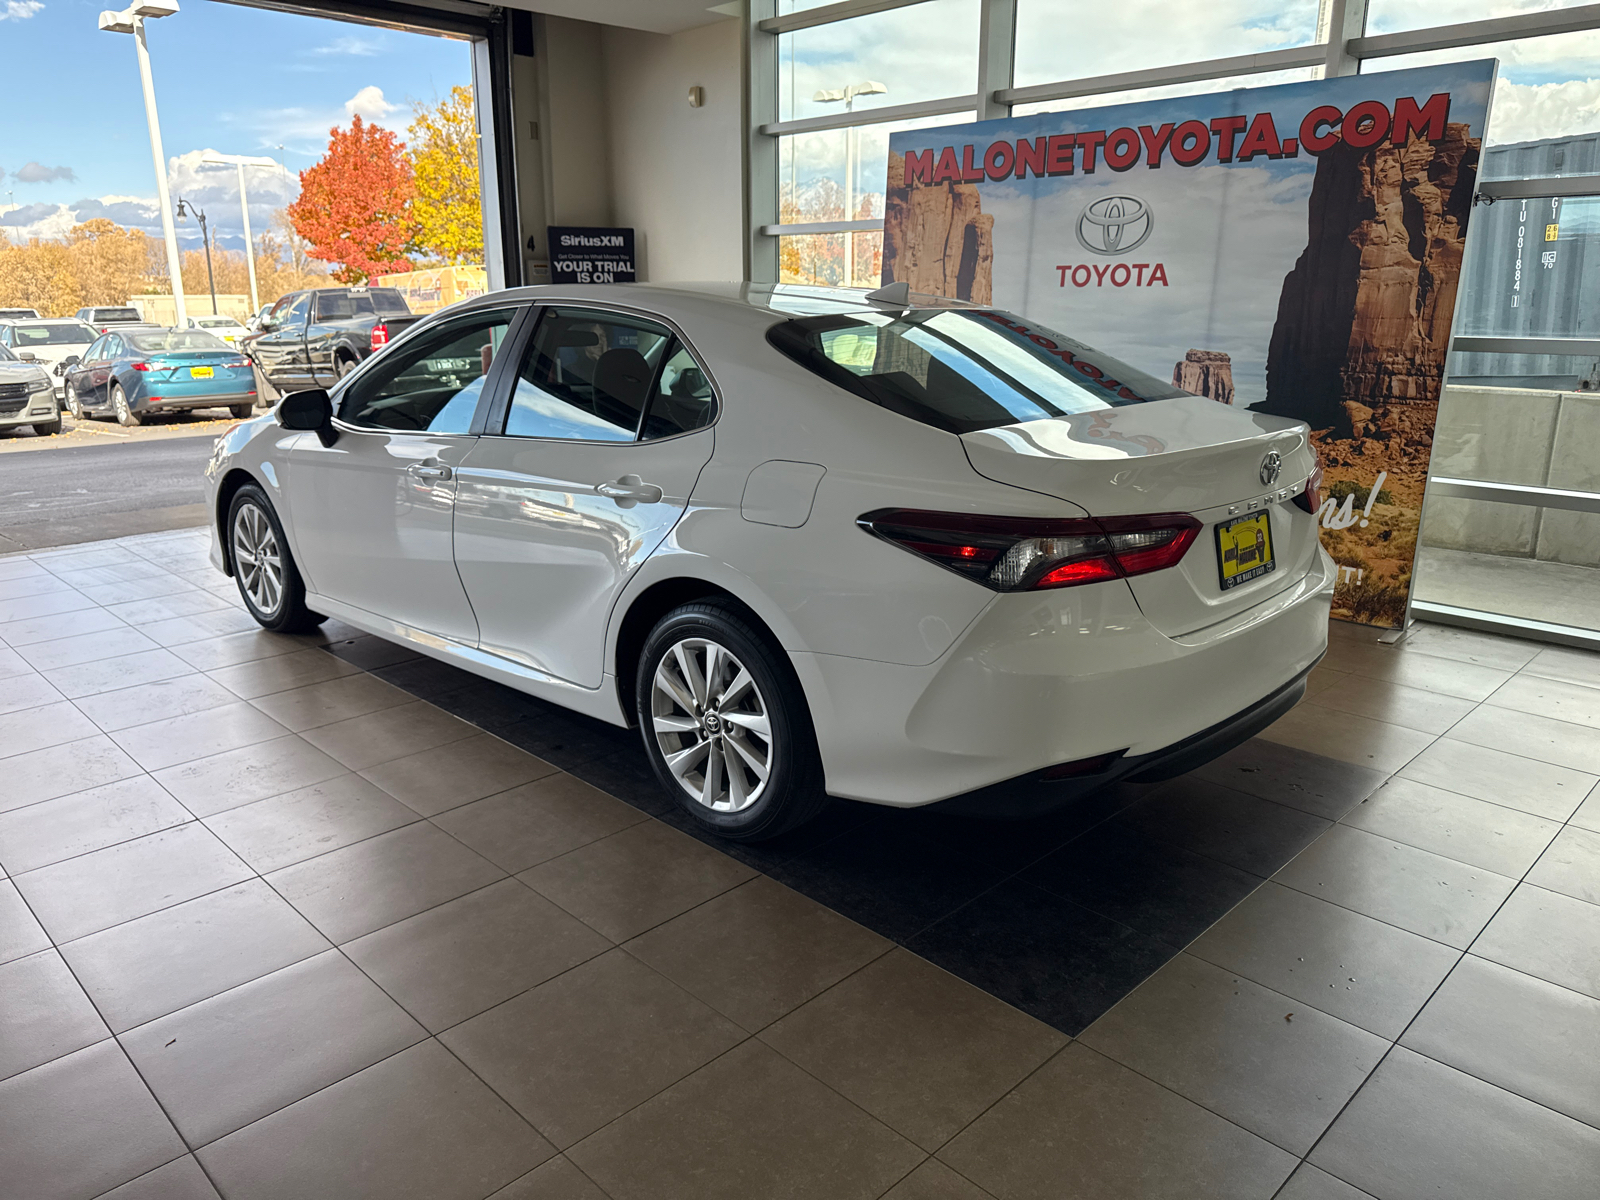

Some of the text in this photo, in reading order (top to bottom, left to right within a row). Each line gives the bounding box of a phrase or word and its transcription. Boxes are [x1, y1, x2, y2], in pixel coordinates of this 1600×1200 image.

[903, 92, 1452, 187] MALONETOYOTA.COM
[527, 235, 535, 252] 4
[560, 235, 624, 247] SiriusXM
[554, 261, 592, 272] YOUR
[595, 261, 635, 272] TRIAL
[1056, 263, 1169, 288] TOYOTA
[577, 272, 614, 283] IS ON
[1318, 471, 1387, 530] ns!
[1336, 565, 1363, 585] T!
